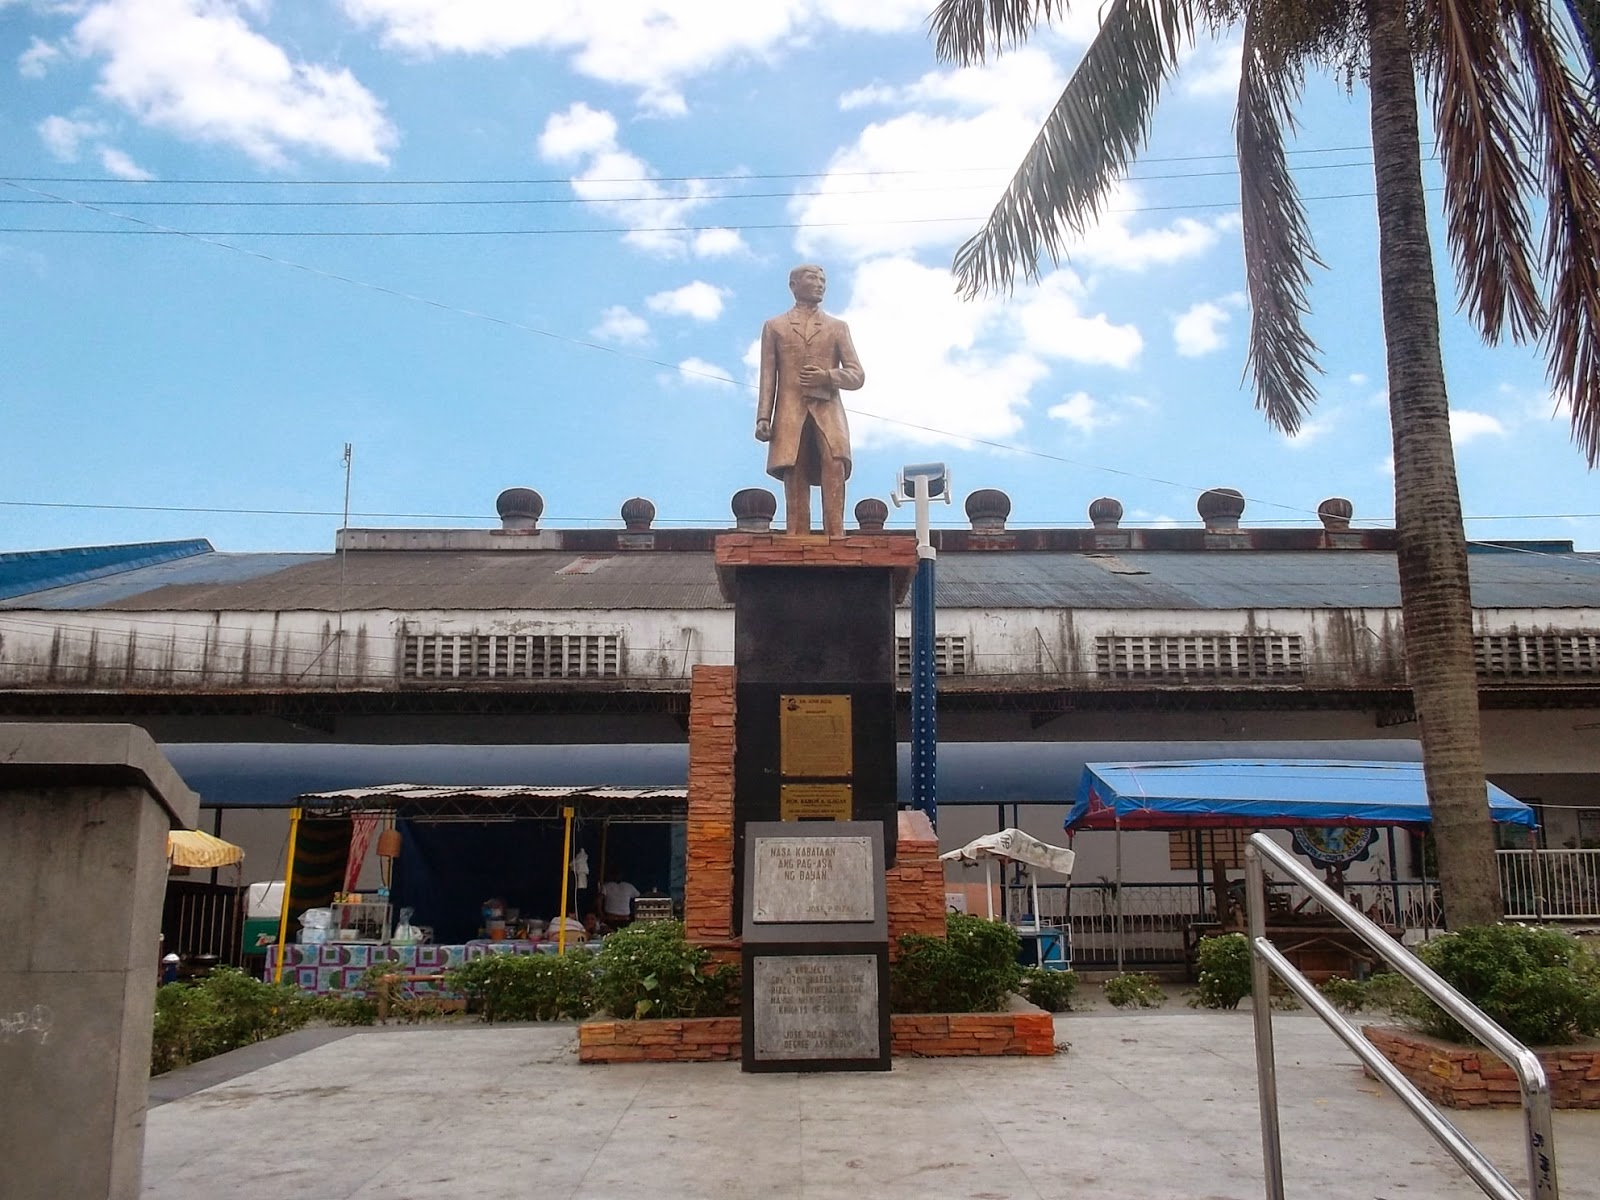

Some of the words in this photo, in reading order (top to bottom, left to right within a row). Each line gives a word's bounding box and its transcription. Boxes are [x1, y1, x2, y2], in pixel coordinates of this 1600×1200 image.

[770, 847, 791, 857] NASA
[795, 846, 836, 857] KABATAAN
[777, 859, 794, 869] ANG
[796, 858, 833, 870] PAG-ASA
[784, 870, 795, 881] NG
[799, 870, 827, 881] BAYAN
[784, 1030, 802, 1039] JOSE
[784, 1040, 809, 1049] DEGREE
